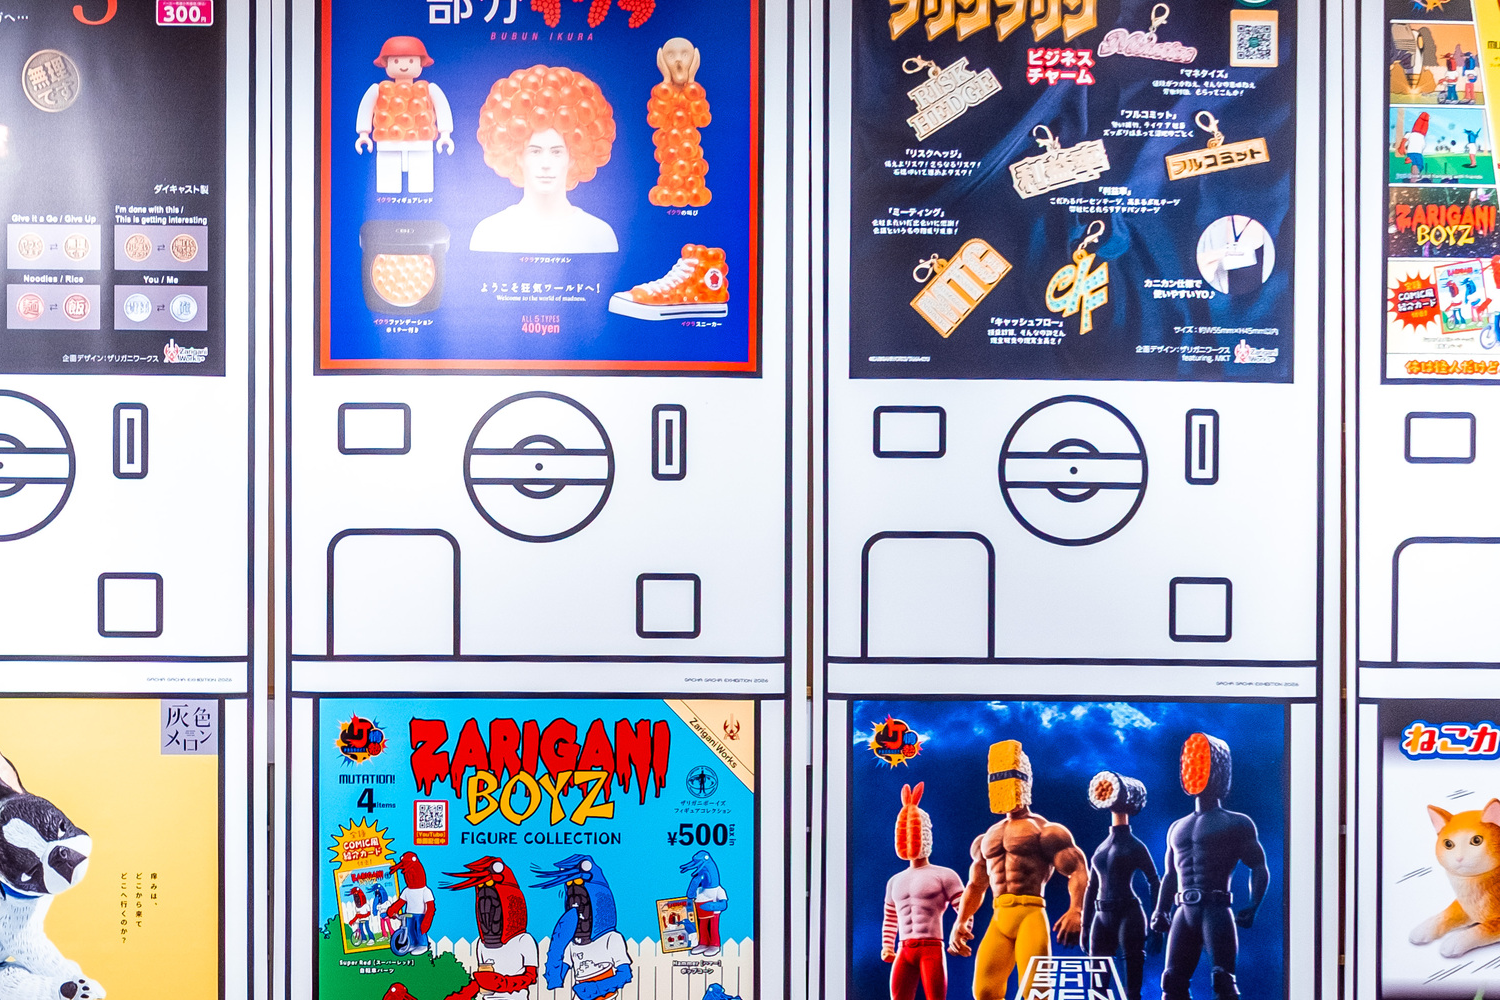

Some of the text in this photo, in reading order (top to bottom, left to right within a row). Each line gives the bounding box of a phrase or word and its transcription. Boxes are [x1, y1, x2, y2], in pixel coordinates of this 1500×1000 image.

[490, 32, 595, 41] BUBUN IKURA
[1027, 48, 1095, 67] ビジネス
[27, 56, 67, 91] 無理
[1027, 67, 1095, 84] チャーム
[907, 58, 976, 112] RISK
[908, 70, 1000, 139] HEDGE
[905, 148, 963, 159] 『リスクヘッジ』
[1171, 147, 1263, 176] フルコミット
[153, 184, 209, 195] ダイキャスト製
[115, 205, 126, 214] I'm
[128, 205, 147, 214] done
[148, 205, 164, 214] with
[165, 205, 180, 214] this
[888, 207, 946, 218] 『ミーティング』
[11, 214, 30, 223] Give
[31, 214, 38, 222] it
[46, 214, 58, 223] Go
[64, 215, 83, 223] Give
[84, 215, 97, 224] Up
[115, 216, 208, 226] This is getting interesting
[1395, 204, 1497, 236] ZARIGANI
[1416, 224, 1475, 246] BOYZ
[23, 275, 58, 284] Noodles
[65, 275, 84, 284] Rice
[143, 276, 158, 284] You
[166, 276, 179, 284] Me
[496, 294, 522, 302] Welcome
[68, 299, 86, 316] 飯
[521, 315, 534, 323] ALL
[541, 315, 560, 323] TYPES
[990, 317, 1065, 328] 『キャッシュフロー』
[521, 323, 561, 336] 400yen
[165, 703, 212, 729] 灰色
[164, 729, 213, 752] メロン
[688, 717, 738, 770] Zarigani Works
[409, 716, 671, 805] ZARIGANI
[338, 774, 396, 784] MUTATION!
[356, 788, 397, 814] 4 items
[464, 770, 615, 826] BOYZ
[460, 831, 622, 845] FIGURE COLLECTION
[666, 822, 729, 847] ¥500
[120, 872, 128, 944] どこへ行くのか？
[135, 872, 143, 928] どこから来て
[1035, 960, 1108, 973] OSU
[1031, 973, 1103, 987] SHI
